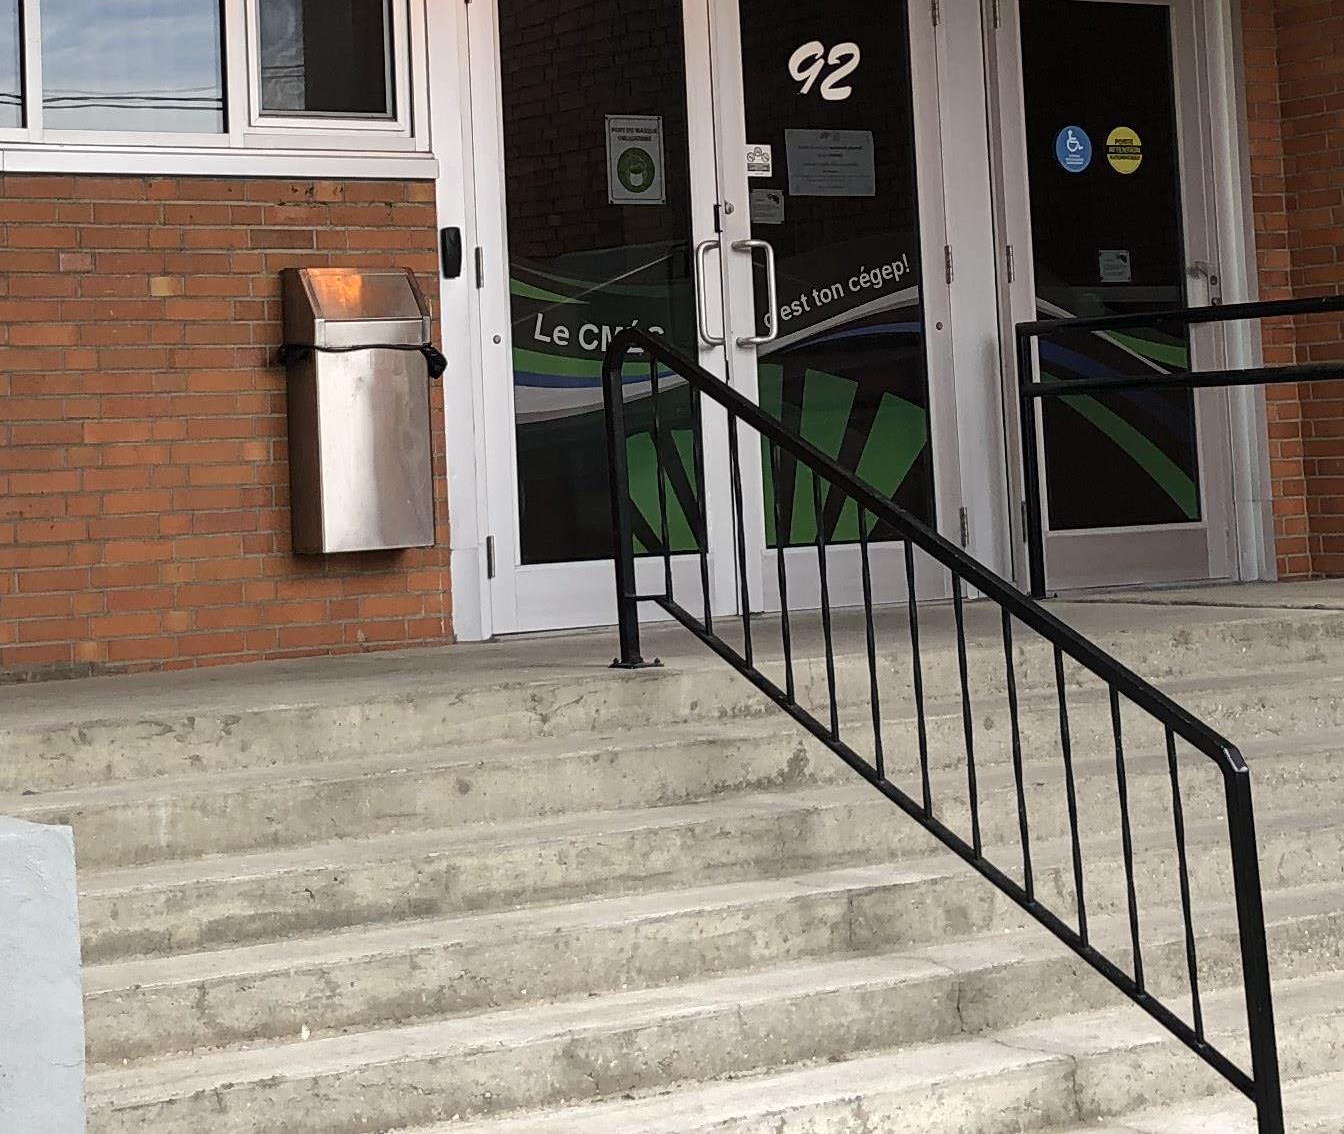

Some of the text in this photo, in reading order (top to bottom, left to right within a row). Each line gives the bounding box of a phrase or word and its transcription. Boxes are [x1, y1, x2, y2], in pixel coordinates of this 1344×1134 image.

[788, 40, 861, 101] 92
[812, 282, 845, 307] ton
[848, 253, 911, 292] cégep!
[533, 312, 665, 355] Le CM
